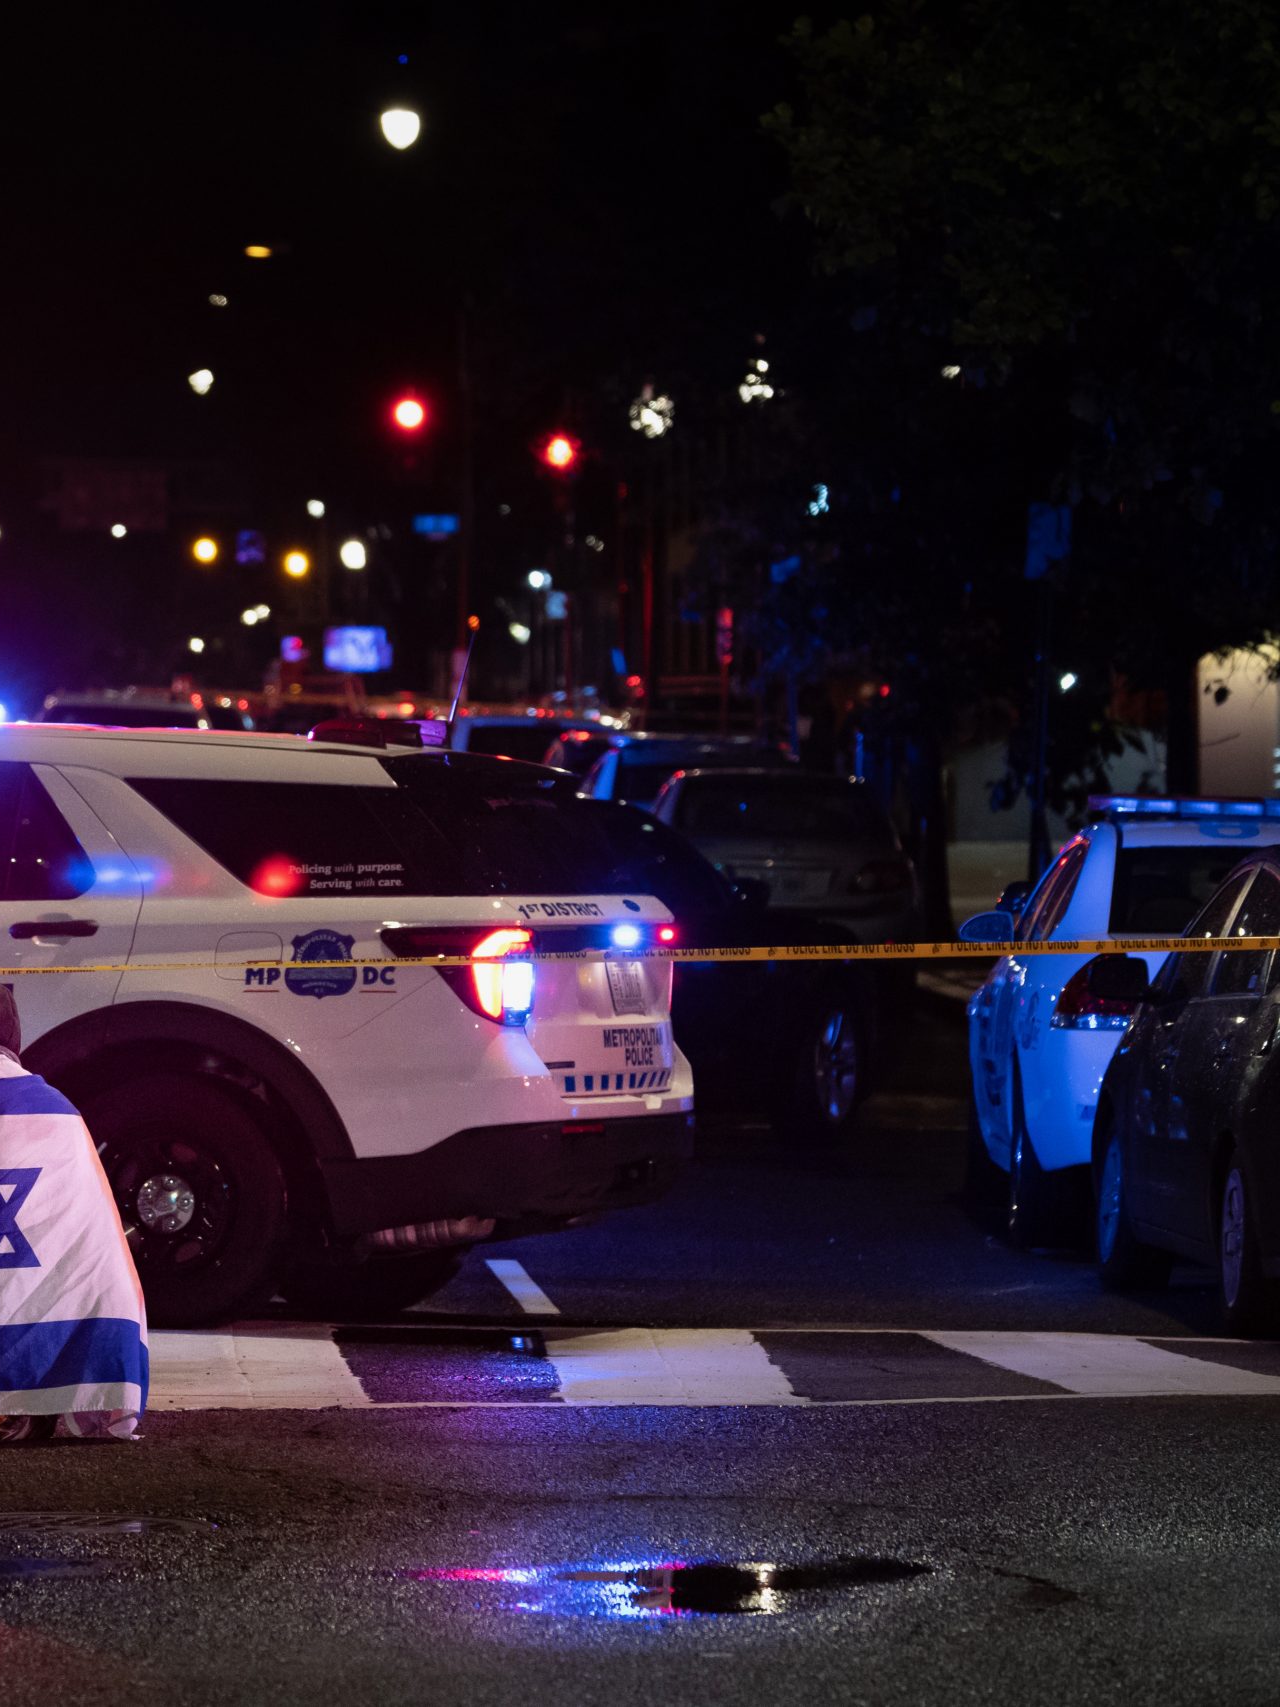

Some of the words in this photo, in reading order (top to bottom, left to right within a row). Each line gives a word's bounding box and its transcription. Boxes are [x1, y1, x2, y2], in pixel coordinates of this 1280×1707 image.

[288, 863, 332, 875] Policing
[333, 863, 354, 873] with
[357, 863, 405, 875] purpose.
[310, 878, 352, 890] Serving
[355, 877, 375, 887] with
[377, 878, 404, 888] care.
[540, 903, 604, 917] DISTRICT
[245, 968, 281, 985] MP
[362, 966, 397, 985] DC
[603, 1027, 663, 1048] METROPOLITAN
[625, 1047, 653, 1066] POLICE
